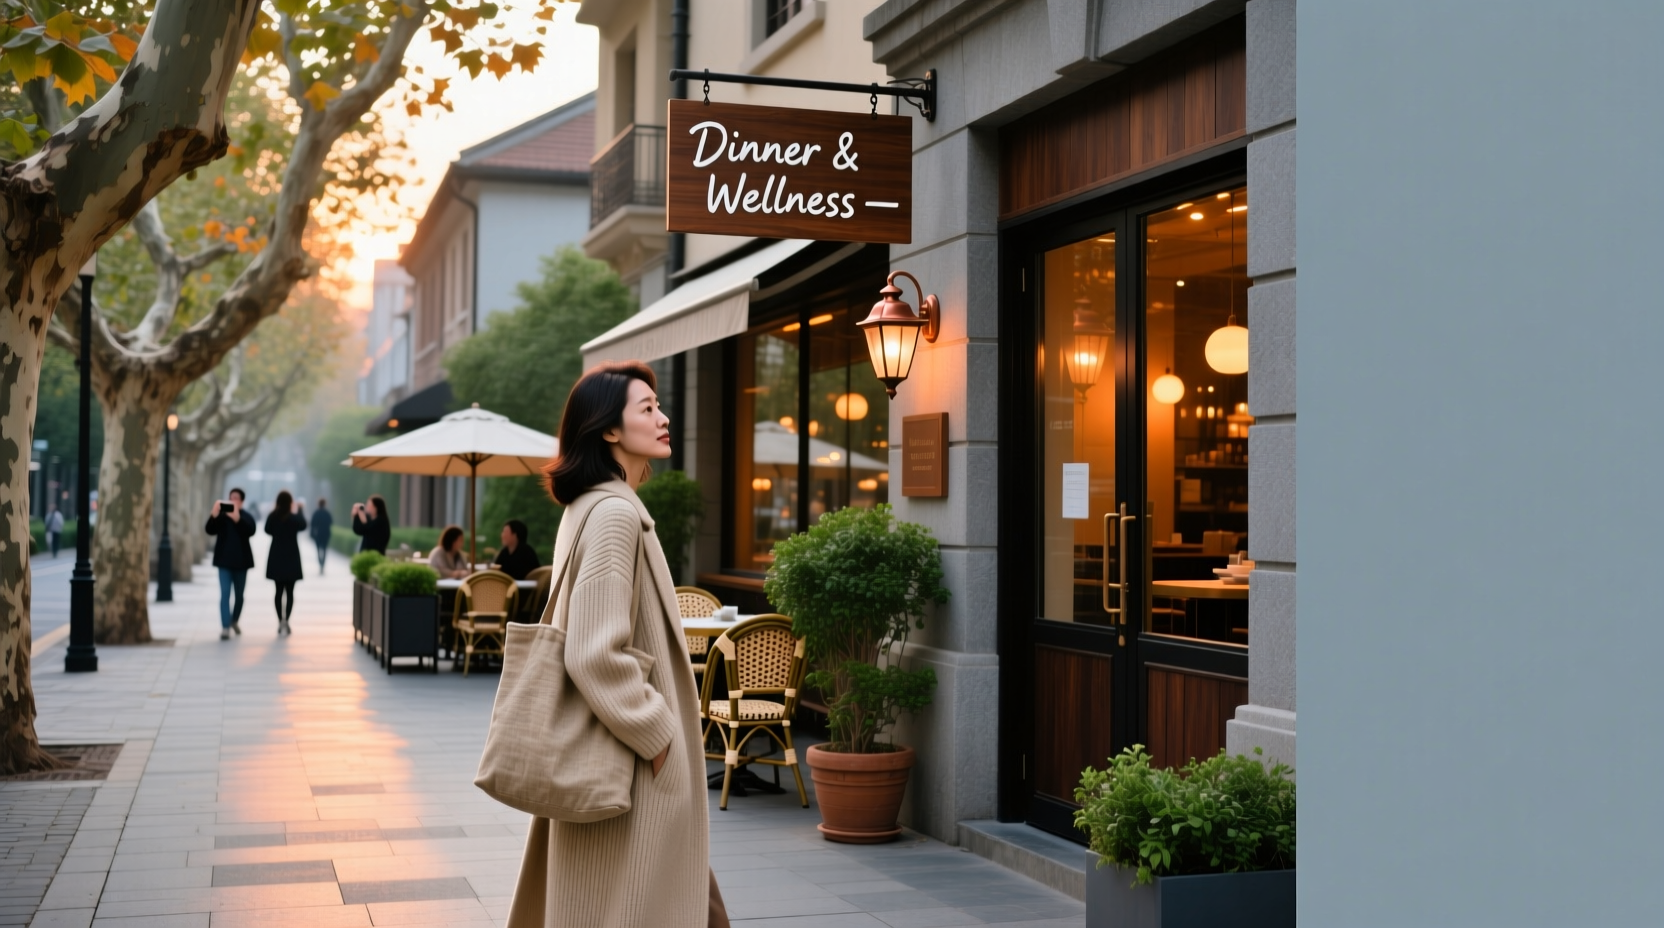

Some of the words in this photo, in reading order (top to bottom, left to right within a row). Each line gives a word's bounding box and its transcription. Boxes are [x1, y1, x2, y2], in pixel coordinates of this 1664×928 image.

[689, 121, 821, 167] Dinner
[832, 131, 859, 172] &
[707, 172, 855, 219] Wellness
